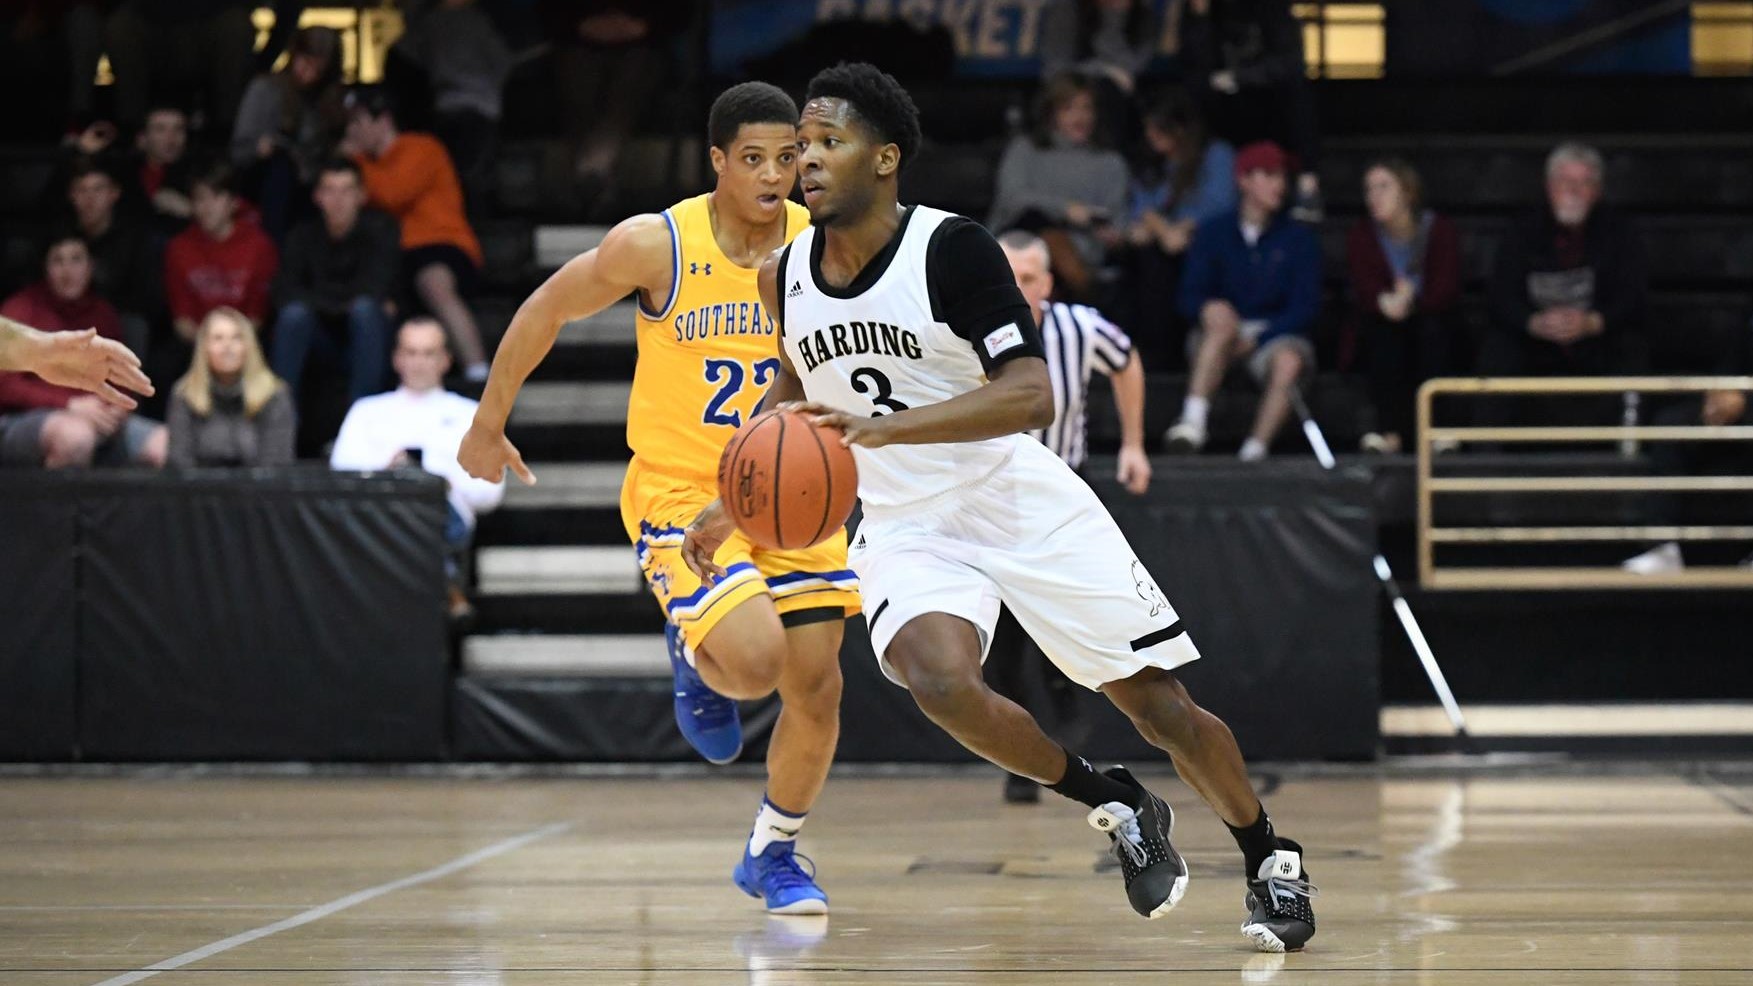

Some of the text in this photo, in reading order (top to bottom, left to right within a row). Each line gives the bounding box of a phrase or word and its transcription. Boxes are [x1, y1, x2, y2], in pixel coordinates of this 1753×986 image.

[675, 302, 775, 342] SOUTHEAS
[798, 321, 922, 373] HARDING
[703, 358, 780, 428] 22
[851, 367, 909, 418] 3
